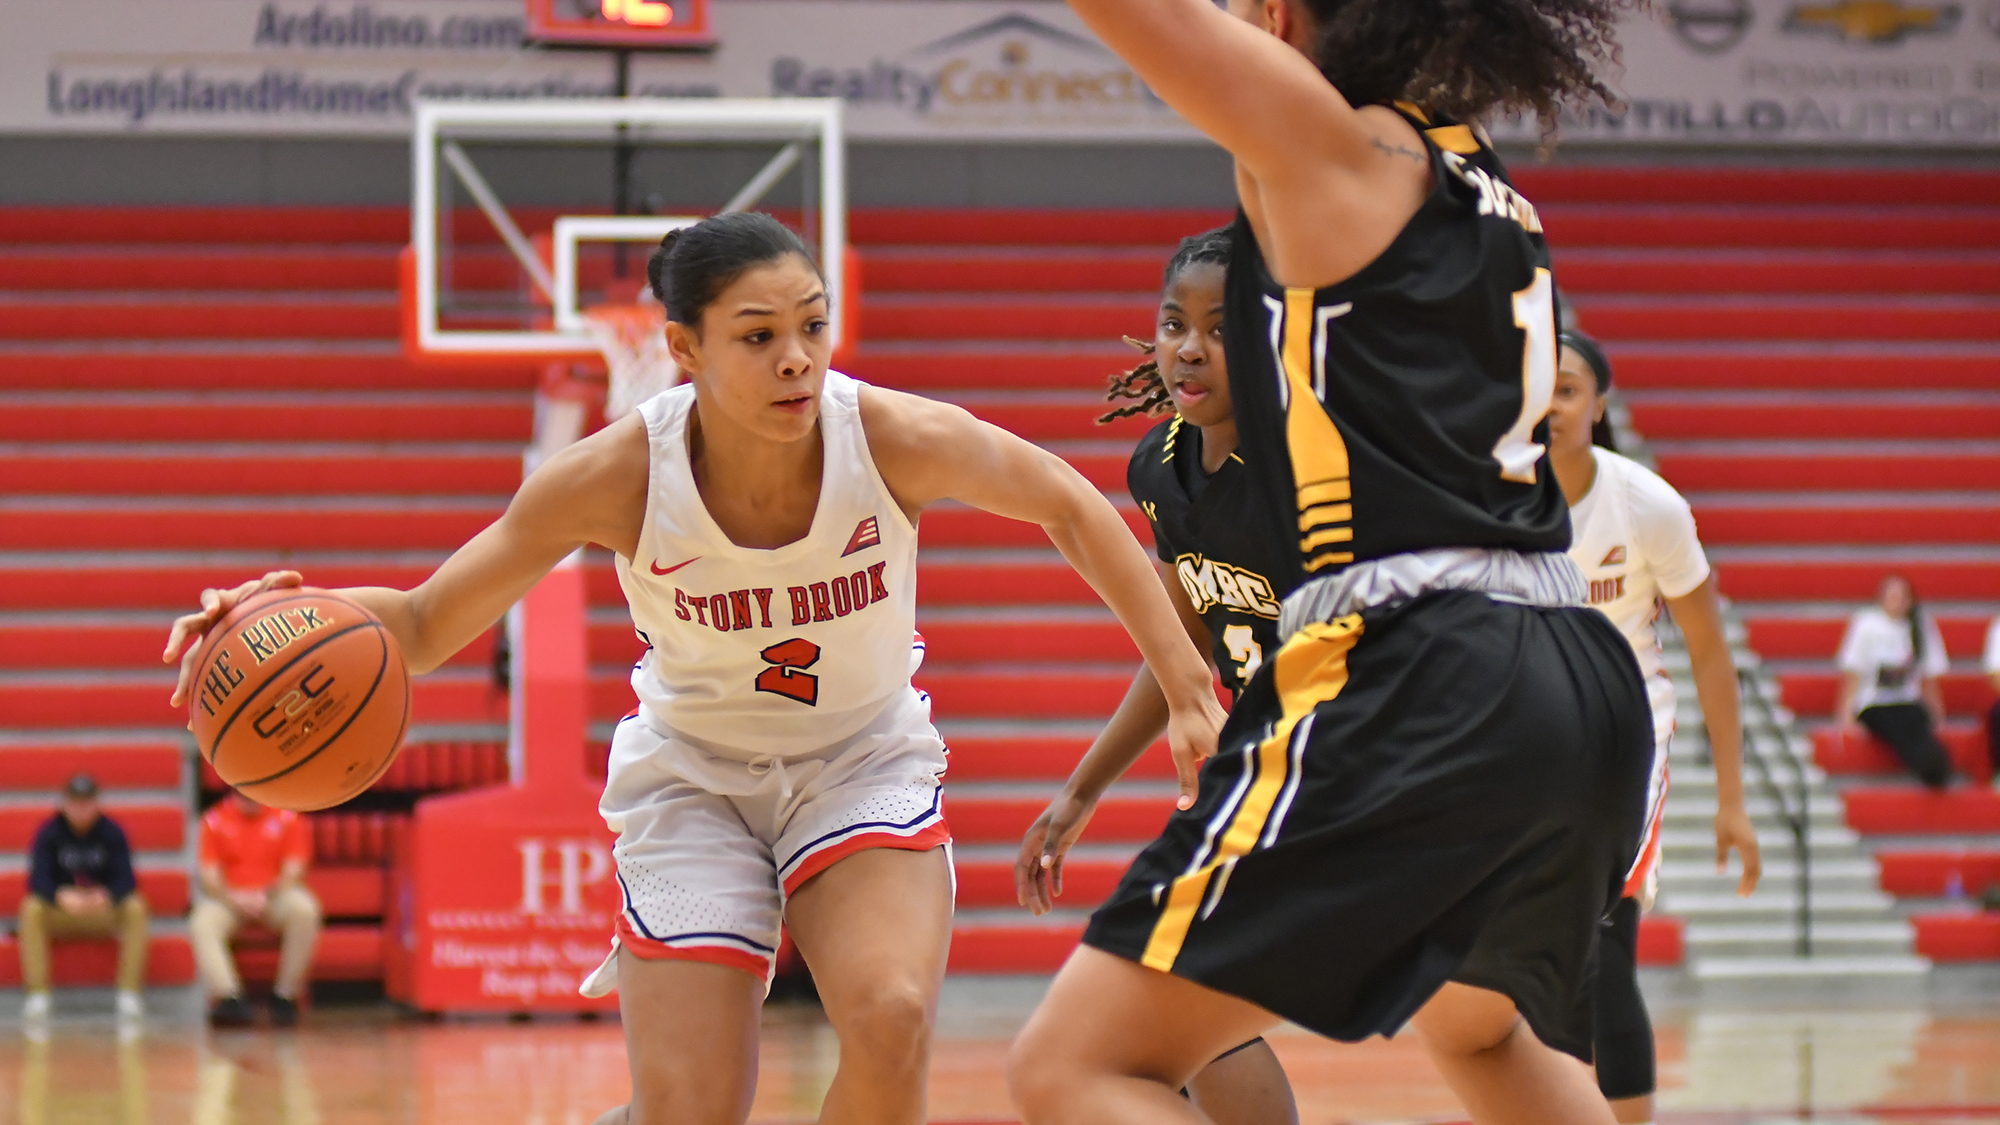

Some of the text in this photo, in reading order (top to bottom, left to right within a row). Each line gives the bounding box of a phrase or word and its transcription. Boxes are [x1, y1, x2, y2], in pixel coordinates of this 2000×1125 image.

[1492, 266, 1559, 485] 1
[674, 560, 889, 632] STONY BROOK
[1589, 574, 1628, 605] OOK
[200, 649, 246, 717] THE
[253, 664, 336, 739] C2C
[755, 637, 822, 708] 2
[517, 839, 610, 916] HP
